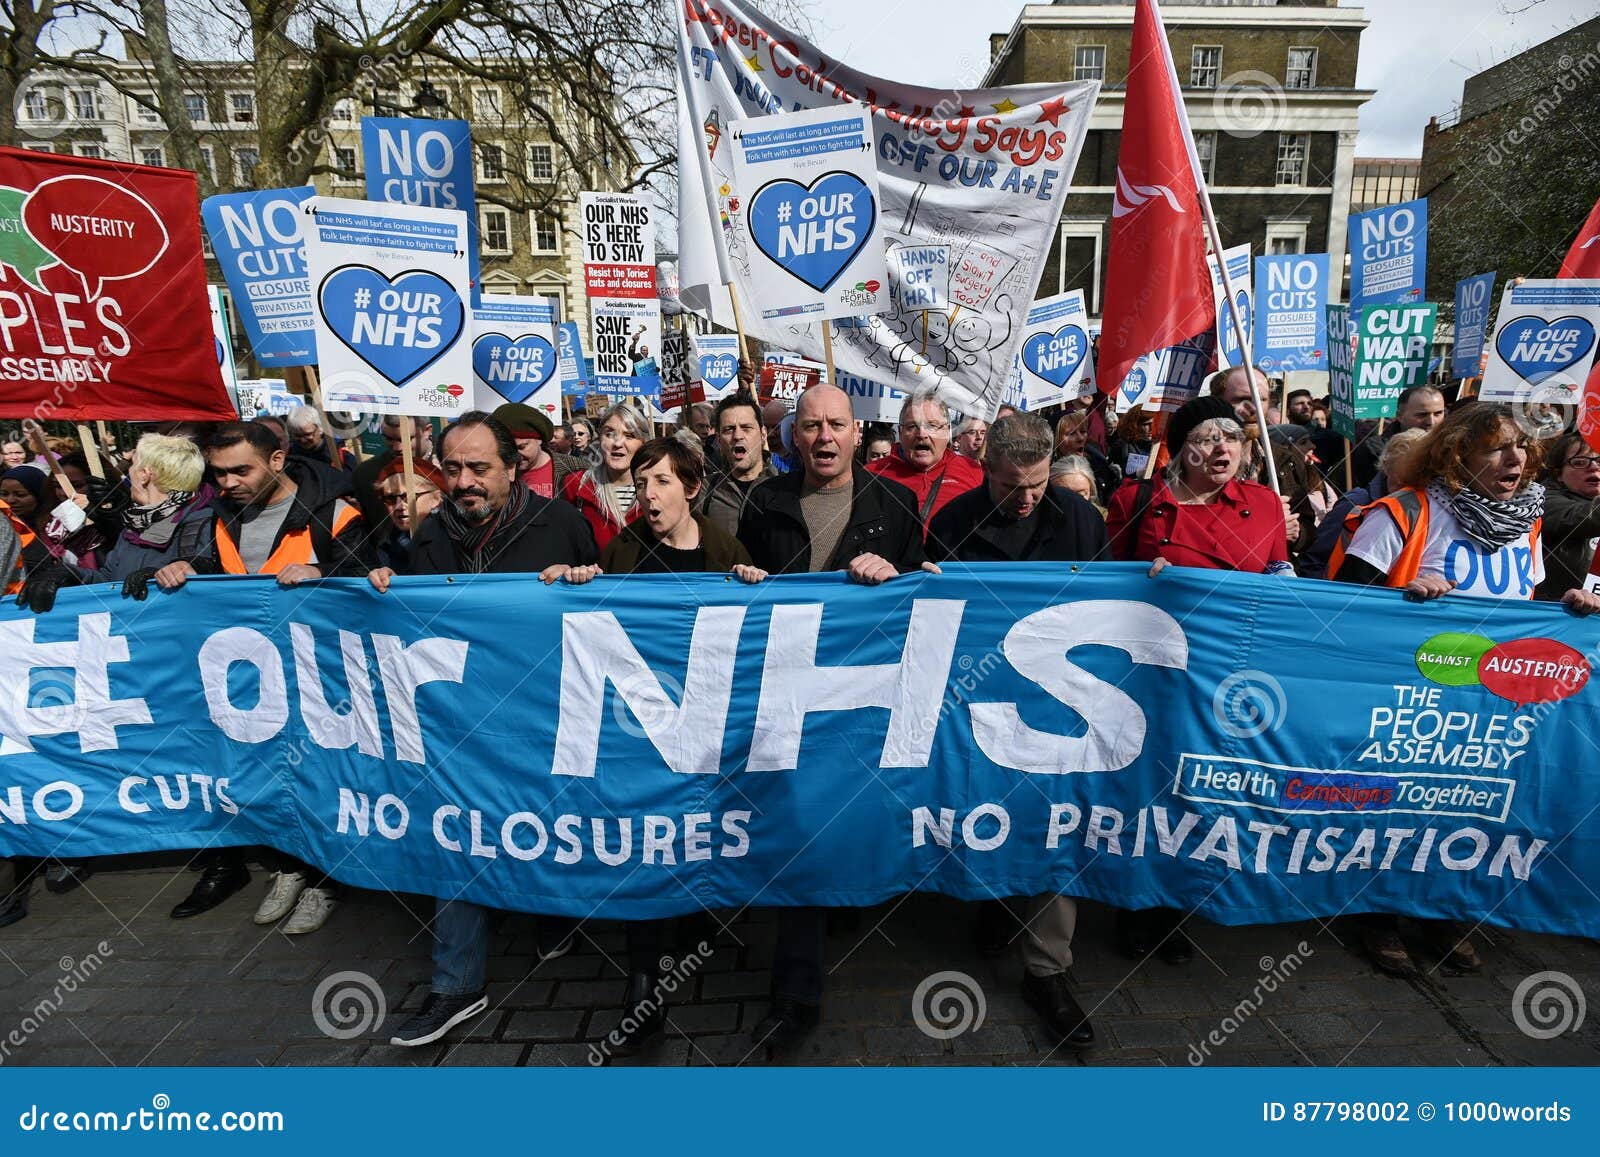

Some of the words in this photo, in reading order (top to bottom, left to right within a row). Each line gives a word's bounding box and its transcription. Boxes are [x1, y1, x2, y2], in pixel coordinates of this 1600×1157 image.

[744, 136, 756, 144] The
[758, 134, 772, 144] NHS
[772, 132, 784, 142] will
[786, 130, 798, 139] last
[798, 130, 806, 138] as
[806, 127, 822, 138] long
[832, 124, 849, 134] there
[851, 122, 861, 130] are
[974, 118, 1066, 166] Says
[378, 128, 454, 178] NO
[880, 133, 935, 172] OFF
[939, 154, 998, 189] OUR
[1000, 167, 1059, 200] A+E
[384, 179, 457, 209] CUTS
[586, 204, 615, 224] OUR
[620, 206, 649, 225] NHS
[778, 201, 792, 223] #
[799, 193, 854, 219] OUR
[50, 213, 135, 238] AUSTERITY
[220, 200, 304, 249] NO
[319, 215, 334, 224] The
[336, 217, 353, 226] NHS
[355, 218, 368, 227] will
[370, 219, 382, 228] last
[394, 222, 411, 232] long
[422, 224, 441, 234] there
[443, 227, 456, 235] are
[587, 224, 600, 242] IS
[606, 225, 641, 243] HERE
[1361, 208, 1415, 245] NO
[778, 216, 856, 258] NHS
[1363, 235, 1415, 262] CUTS
[588, 243, 606, 261] TO
[612, 244, 644, 262] STAY
[900, 249, 946, 267] HANDS
[588, 267, 610, 278] Resist
[613, 268, 625, 278] the
[906, 268, 933, 285] OFF
[1268, 260, 1318, 291] NO
[1364, 256, 1412, 274] CLOSURES
[589, 279, 606, 288] cuts
[608, 279, 620, 288] and
[622, 279, 652, 288] closures
[1461, 280, 1486, 310] NO
[354, 288, 371, 308] #
[379, 289, 442, 314] OUR
[595, 308, 614, 316] Defend
[615, 309, 636, 317] migrant
[1268, 291, 1317, 310] CUTS
[261, 320, 278, 331] PAY
[595, 316, 632, 336] SAVE
[1269, 314, 1314, 323] CLOSURES
[1329, 310, 1351, 340] CUT
[1367, 309, 1431, 335] CUT
[1460, 307, 1483, 326] CUTS
[352, 312, 442, 349] NHS
[1536, 328, 1581, 342] OUR
[505, 347, 544, 361] OUR
[596, 335, 627, 354] OUR
[1049, 335, 1077, 352] OUR
[1363, 335, 1427, 360] WAR
[1510, 342, 1578, 363] NHS
[488, 361, 544, 383] NHS
[598, 354, 627, 374] NHS
[714, 360, 732, 368] OUR
[1037, 346, 1079, 374] NHS
[706, 368, 732, 379] NHS
[774, 371, 792, 381] SAVE
[794, 374, 808, 383] HRI
[1358, 361, 1422, 386] NOT
[598, 384, 616, 392] racists
[1330, 369, 1352, 403] NOT
[1357, 388, 1407, 399] WELFA
[1444, 539, 1534, 596] OUR
[1418, 651, 1473, 668] AGAINST
[1484, 656, 1587, 683] AUSTERITY
[198, 622, 469, 765] our
[550, 598, 1188, 777] NHS
[1393, 685, 1443, 708] THE
[1368, 706, 1536, 747] PEOPLES
[1357, 738, 1526, 770] ASSEMBLY
[1191, 763, 1276, 797] Health
[1285, 778, 1392, 810] Campaigns
[1396, 781, 1502, 810] Together
[0, 780, 84, 825] NO
[118, 773, 239, 816] CUTS
[337, 788, 410, 840] NO
[432, 805, 751, 867] CLOSURES
[911, 802, 1011, 852] NO
[1045, 802, 1548, 881] PRIVATISATION
